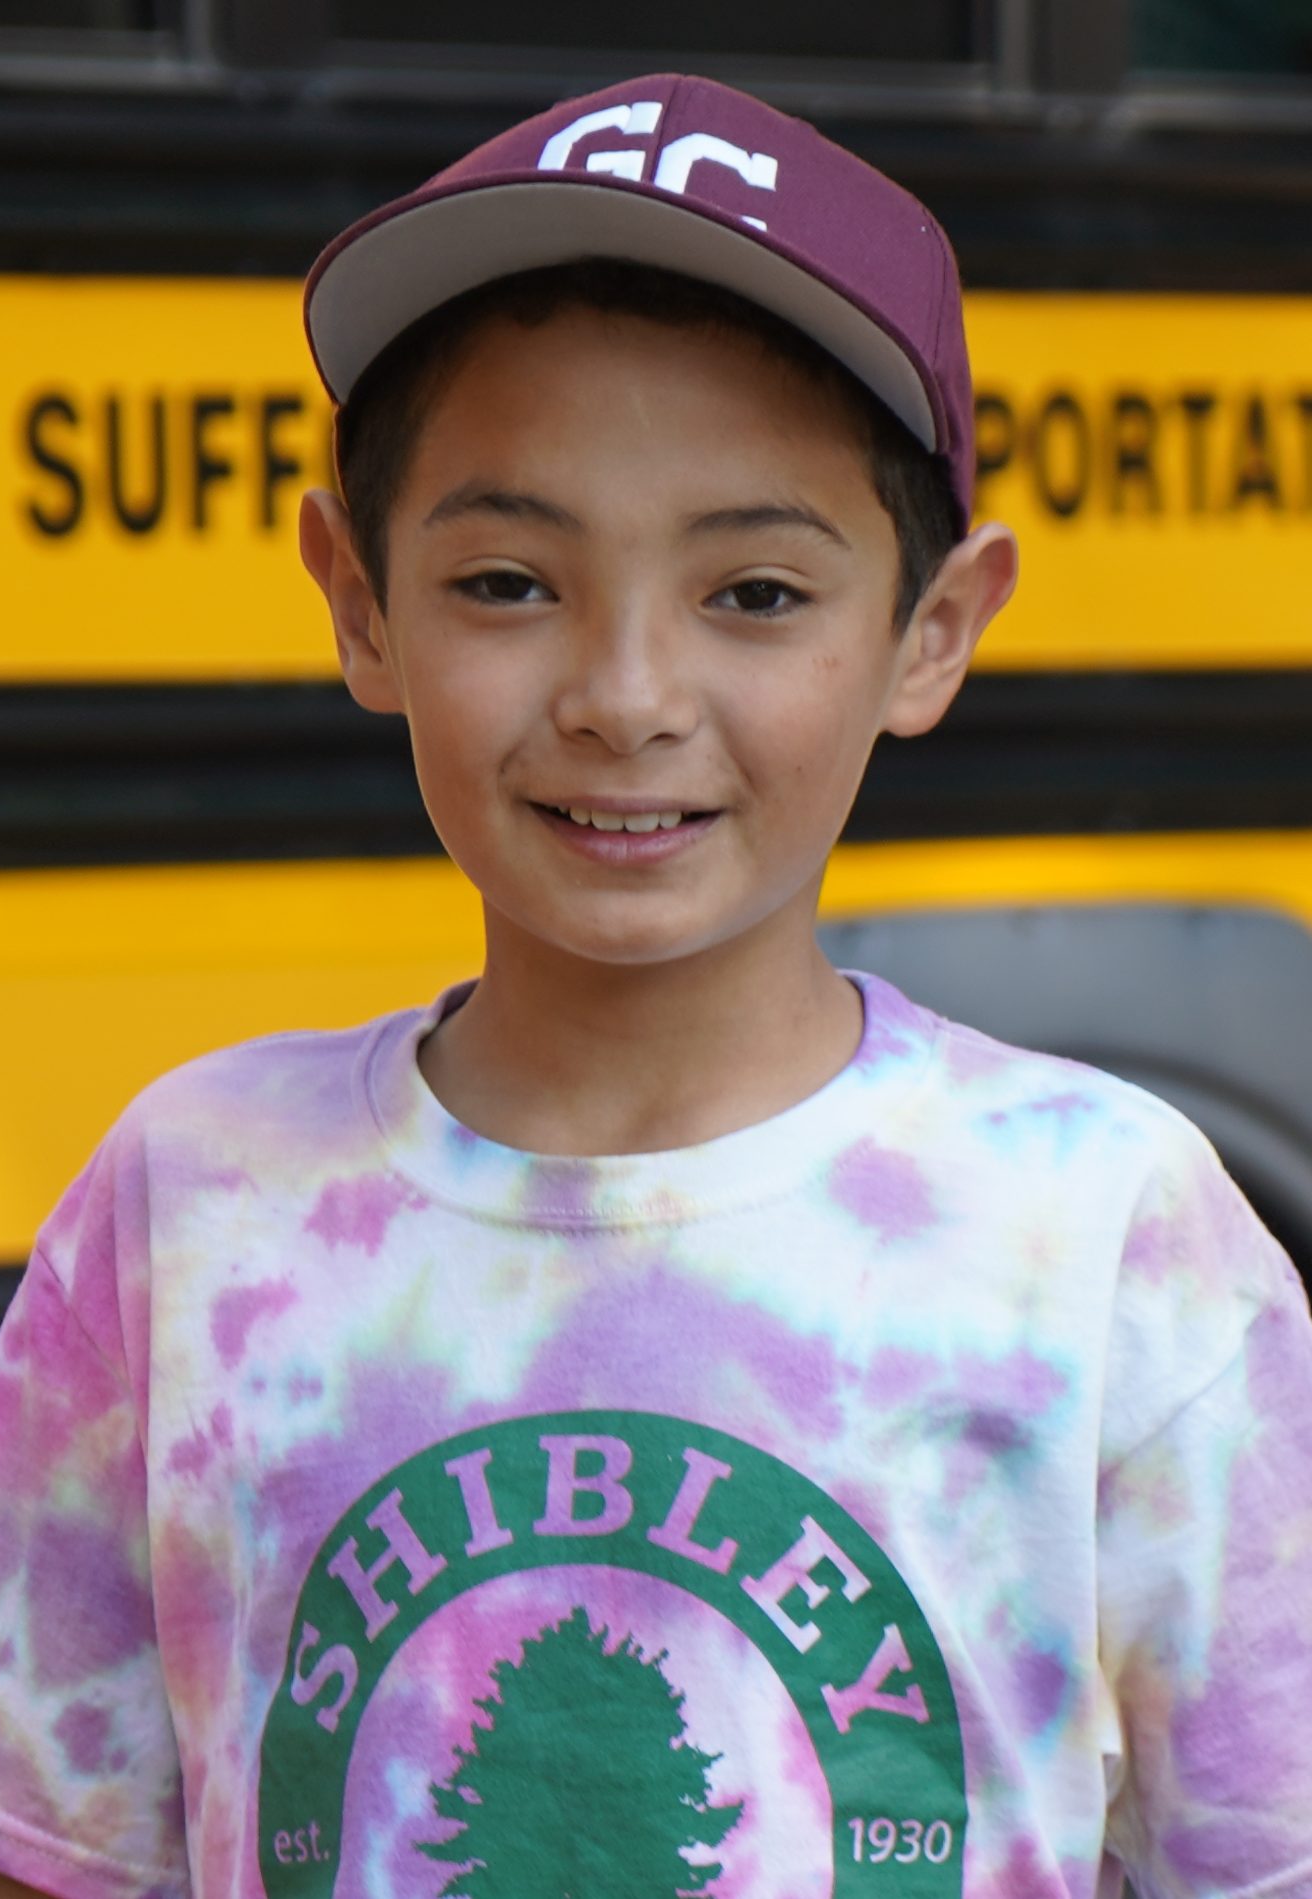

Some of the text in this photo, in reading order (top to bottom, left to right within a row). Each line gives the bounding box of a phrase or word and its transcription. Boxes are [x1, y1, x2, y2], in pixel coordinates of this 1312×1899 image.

[537, 101, 779, 232] GC
[22, 391, 336, 539] SUFF
[290, 1433, 930, 1735] SHIBLEY
[273, 1817, 953, 1864] est. 1930
